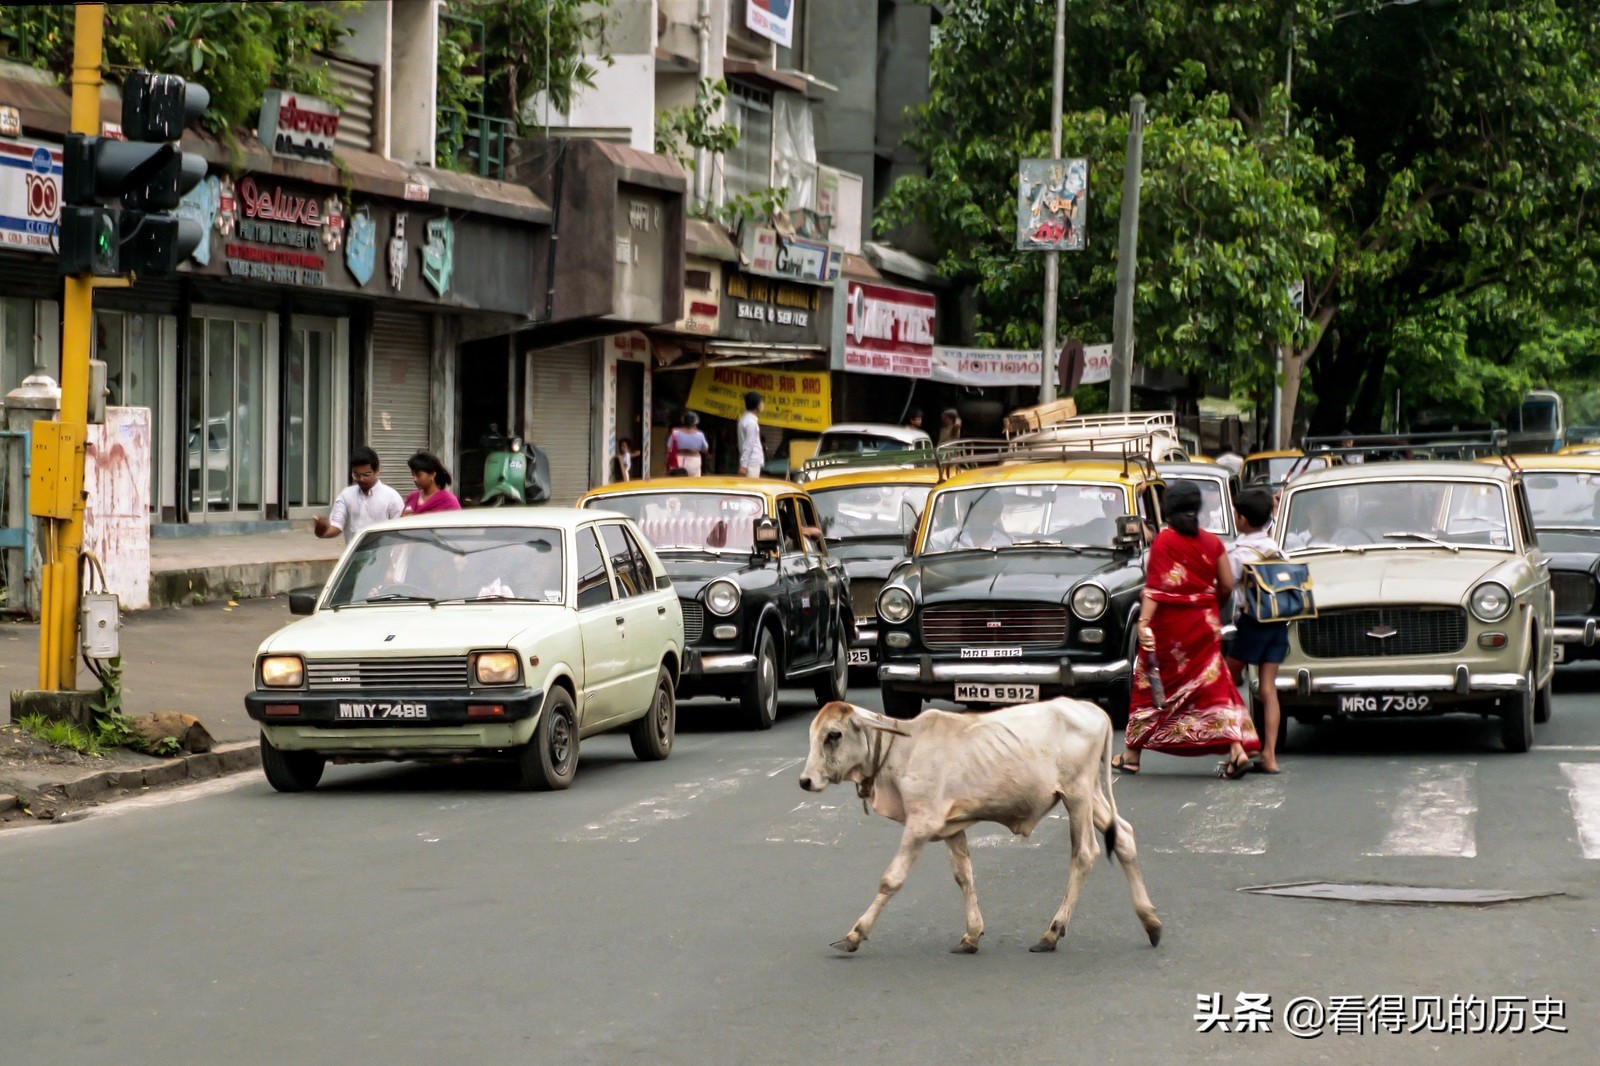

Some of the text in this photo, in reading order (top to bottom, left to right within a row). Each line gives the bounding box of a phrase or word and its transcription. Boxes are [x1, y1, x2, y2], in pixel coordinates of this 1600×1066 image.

[25, 173, 58, 219] 100
[738, 303, 764, 320] SALES
[777, 310, 808, 327] SERVICE
[993, 649, 1020, 657] 6912
[994, 687, 1035, 700] 6912
[339, 703, 428, 718] MMY 7488
[1381, 695, 1429, 712] 7389
